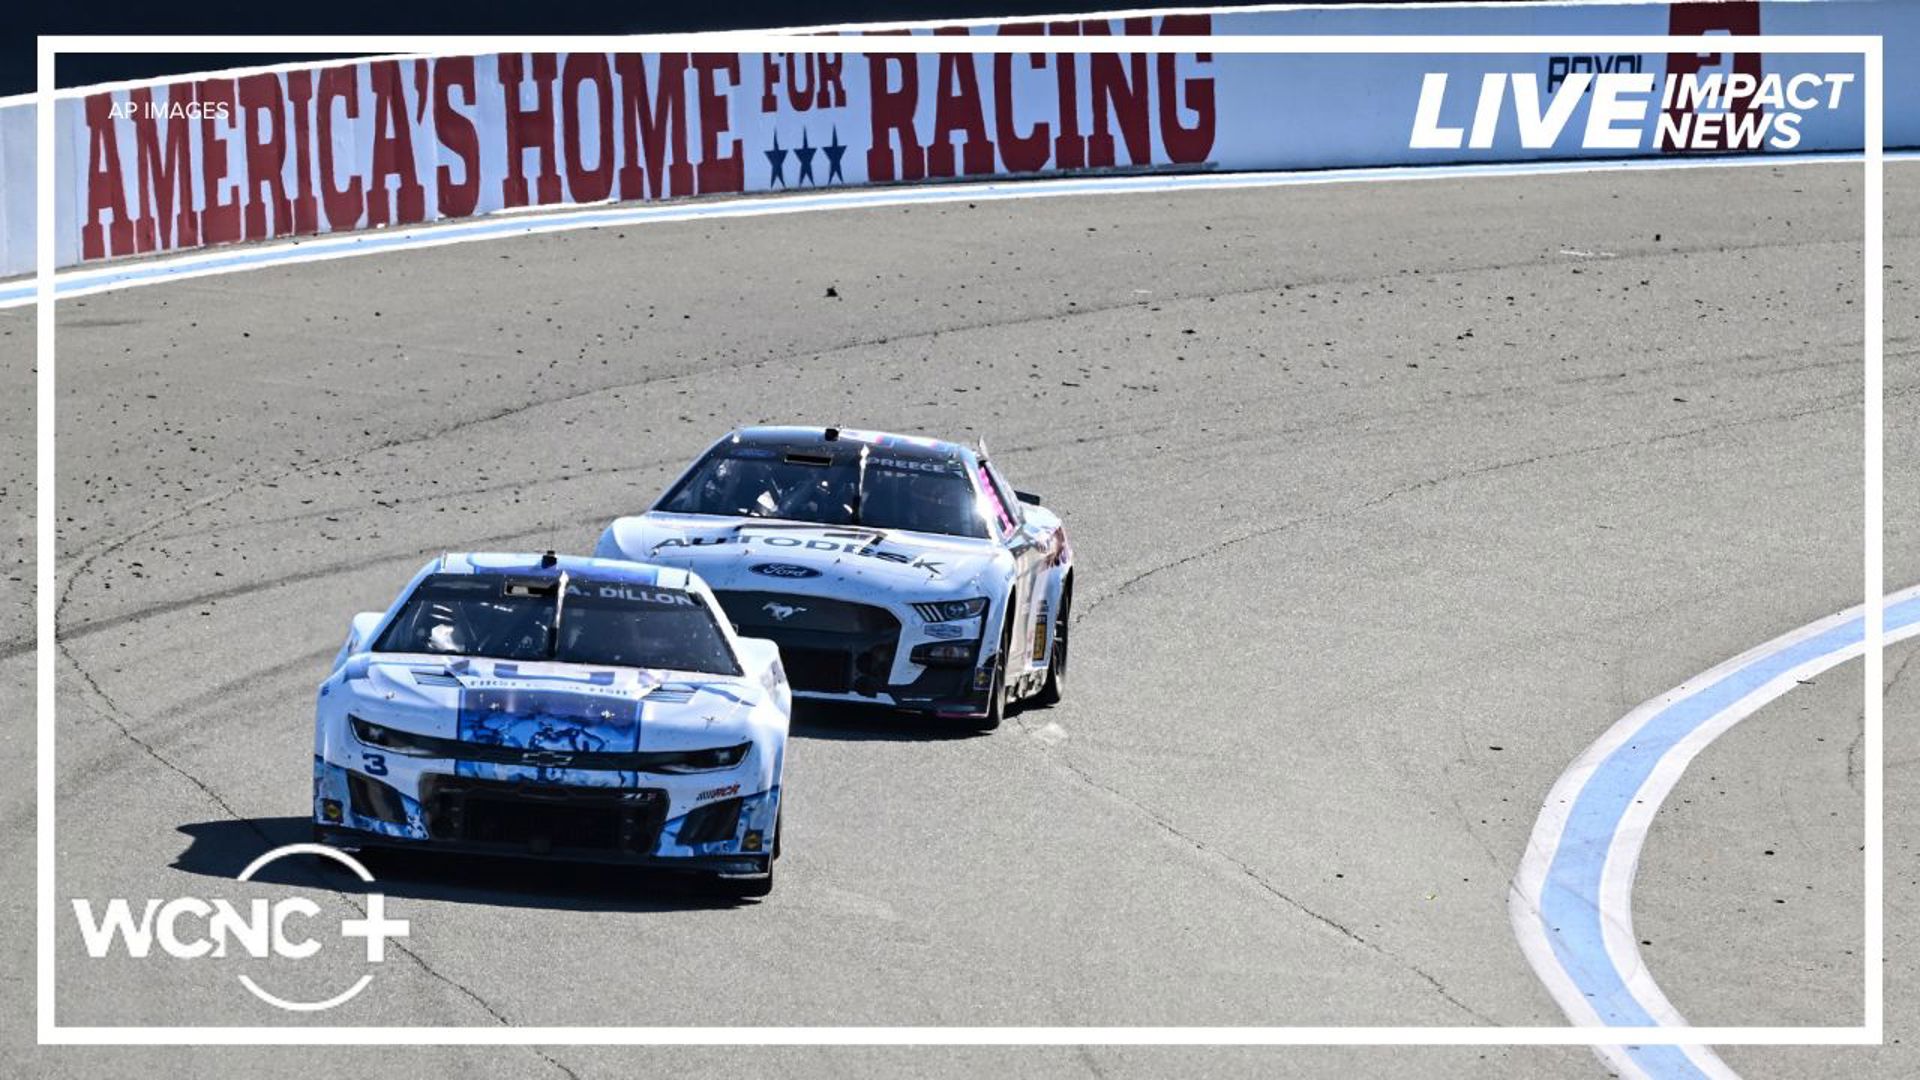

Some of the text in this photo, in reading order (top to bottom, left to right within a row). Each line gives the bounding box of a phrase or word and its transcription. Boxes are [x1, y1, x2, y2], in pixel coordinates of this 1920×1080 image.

[82, 14, 1216, 260] AMERICA'S HOME FOR RACING
[763, 563, 807, 578] Ford
[566, 585, 696, 607] A. DILLON
[362, 752, 389, 776] 3
